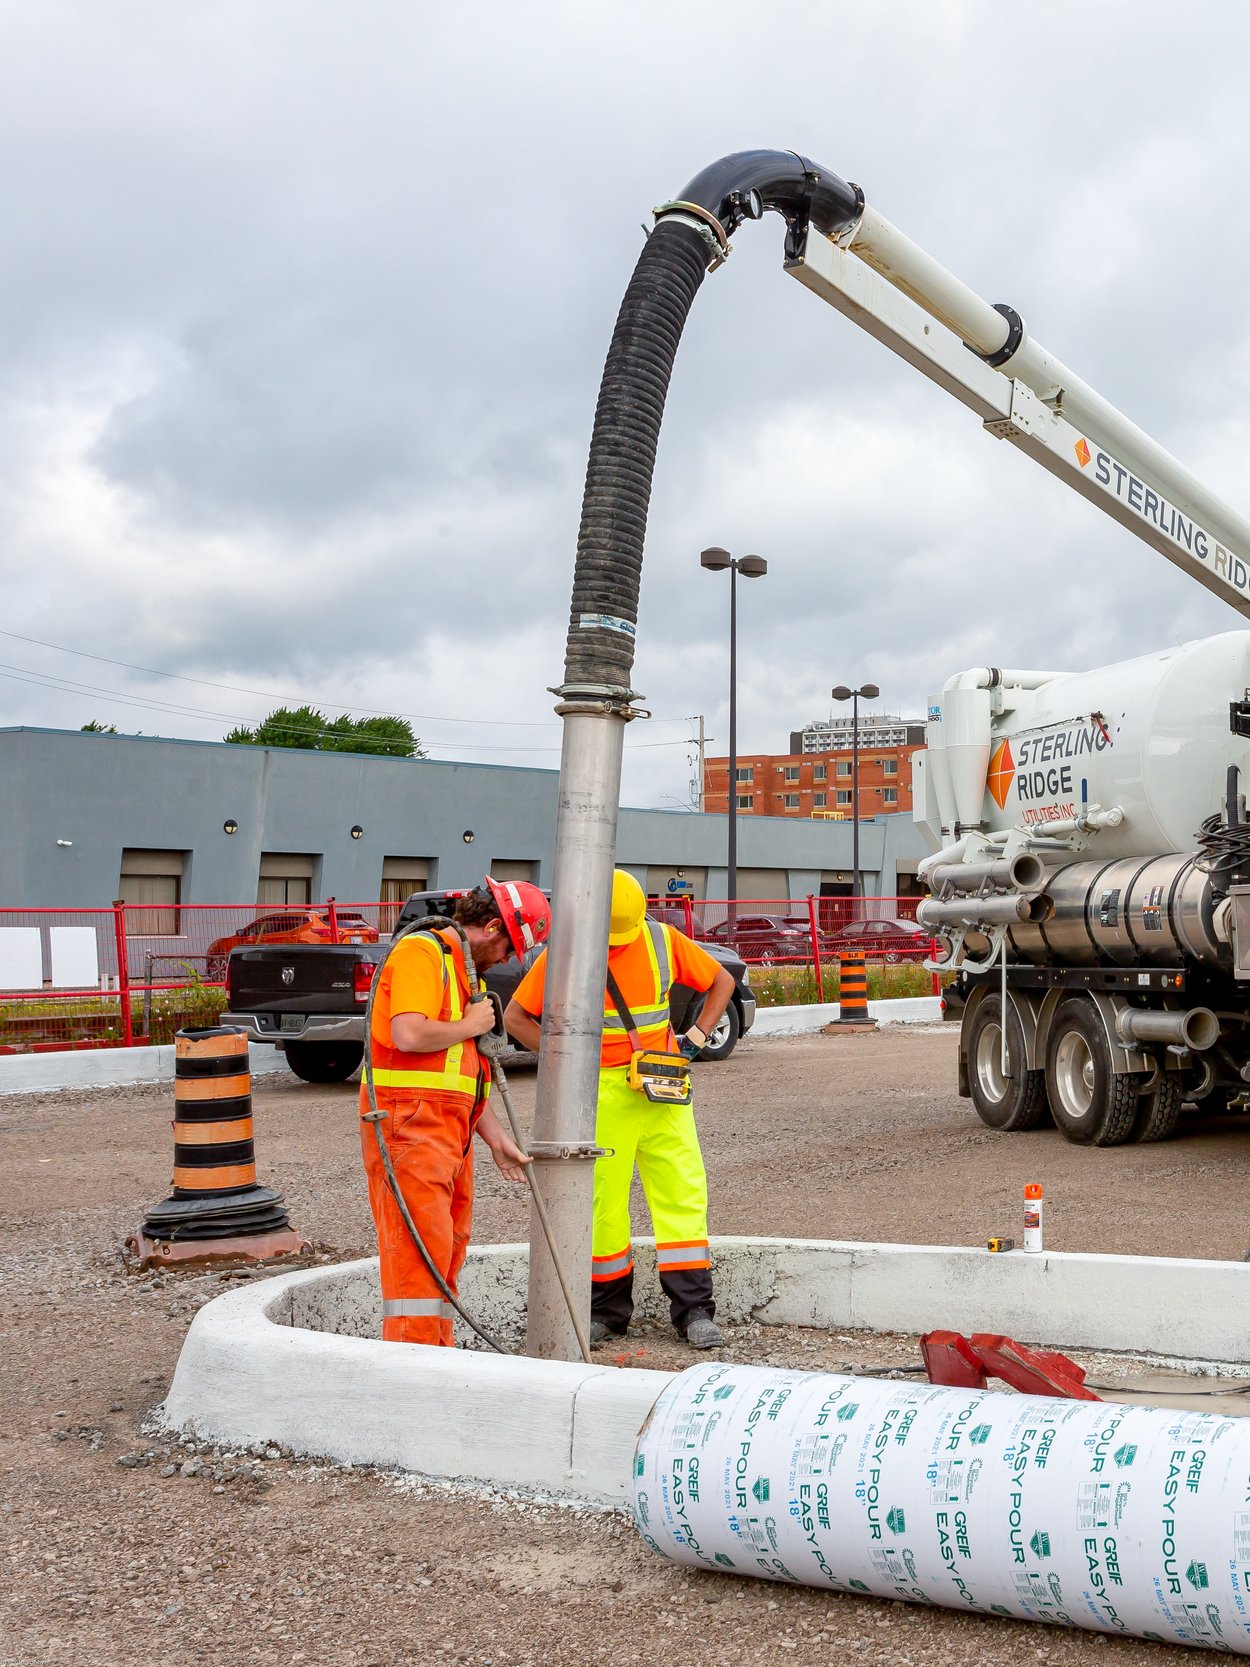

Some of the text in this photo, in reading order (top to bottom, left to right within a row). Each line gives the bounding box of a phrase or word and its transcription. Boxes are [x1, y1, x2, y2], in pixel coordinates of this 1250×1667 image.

[1096, 452, 1208, 559] STERLING
[1018, 723, 1109, 766] STERLING
[1017, 766, 1073, 801] RIDGE
[1021, 803, 1079, 824] UTILITIES INC.
[692, 1368, 730, 1404] POUR
[768, 1389, 792, 1421] GREIF
[814, 1383, 850, 1426] POUR
[795, 1439, 801, 1448] 26
[862, 1433, 872, 1450] MAY
[870, 1423, 875, 1432] 26
[895, 1410, 918, 1446] GREIF
[946, 1401, 980, 1450] POUR
[1084, 1432, 1098, 1453] 18"
[726, 1457, 732, 1466] 26
[735, 1389, 775, 1508] EASY POUR
[791, 1451, 799, 1468] MAY
[1002, 1445, 1016, 1469] 18"
[1035, 1429, 1056, 1469] GREIF
[1090, 1419, 1120, 1473] POUR
[672, 1459, 688, 1520] EASY
[688, 1457, 699, 1503] GREIF
[867, 1410, 900, 1539] EASY POUR
[927, 1461, 938, 1487] 18"
[1186, 1450, 1206, 1494] GREIF
[662, 1474, 668, 1483] 26
[672, 1530, 690, 1548] 18"
[789, 1498, 801, 1523] 18"
[817, 1483, 831, 1530] GREIF
[855, 1480, 866, 1506] 18"
[1009, 1430, 1037, 1563] EASY POUR
[728, 1515, 742, 1538] 18"
[800, 1484, 819, 1547] EASY
[1162, 1450, 1186, 1594] EASY POUR
[937, 1512, 959, 1575] EASY
[955, 1511, 972, 1559] GREIF
[1084, 1538, 1111, 1602] EASY
[1104, 1537, 1123, 1586] GREIF
[1229, 1560, 1236, 1570] 26
[1152, 1577, 1160, 1586] 26
[1156, 1589, 1166, 1606] MAY
[1231, 1573, 1240, 1592] MAY
[1235, 1595, 1245, 1615] 2021
